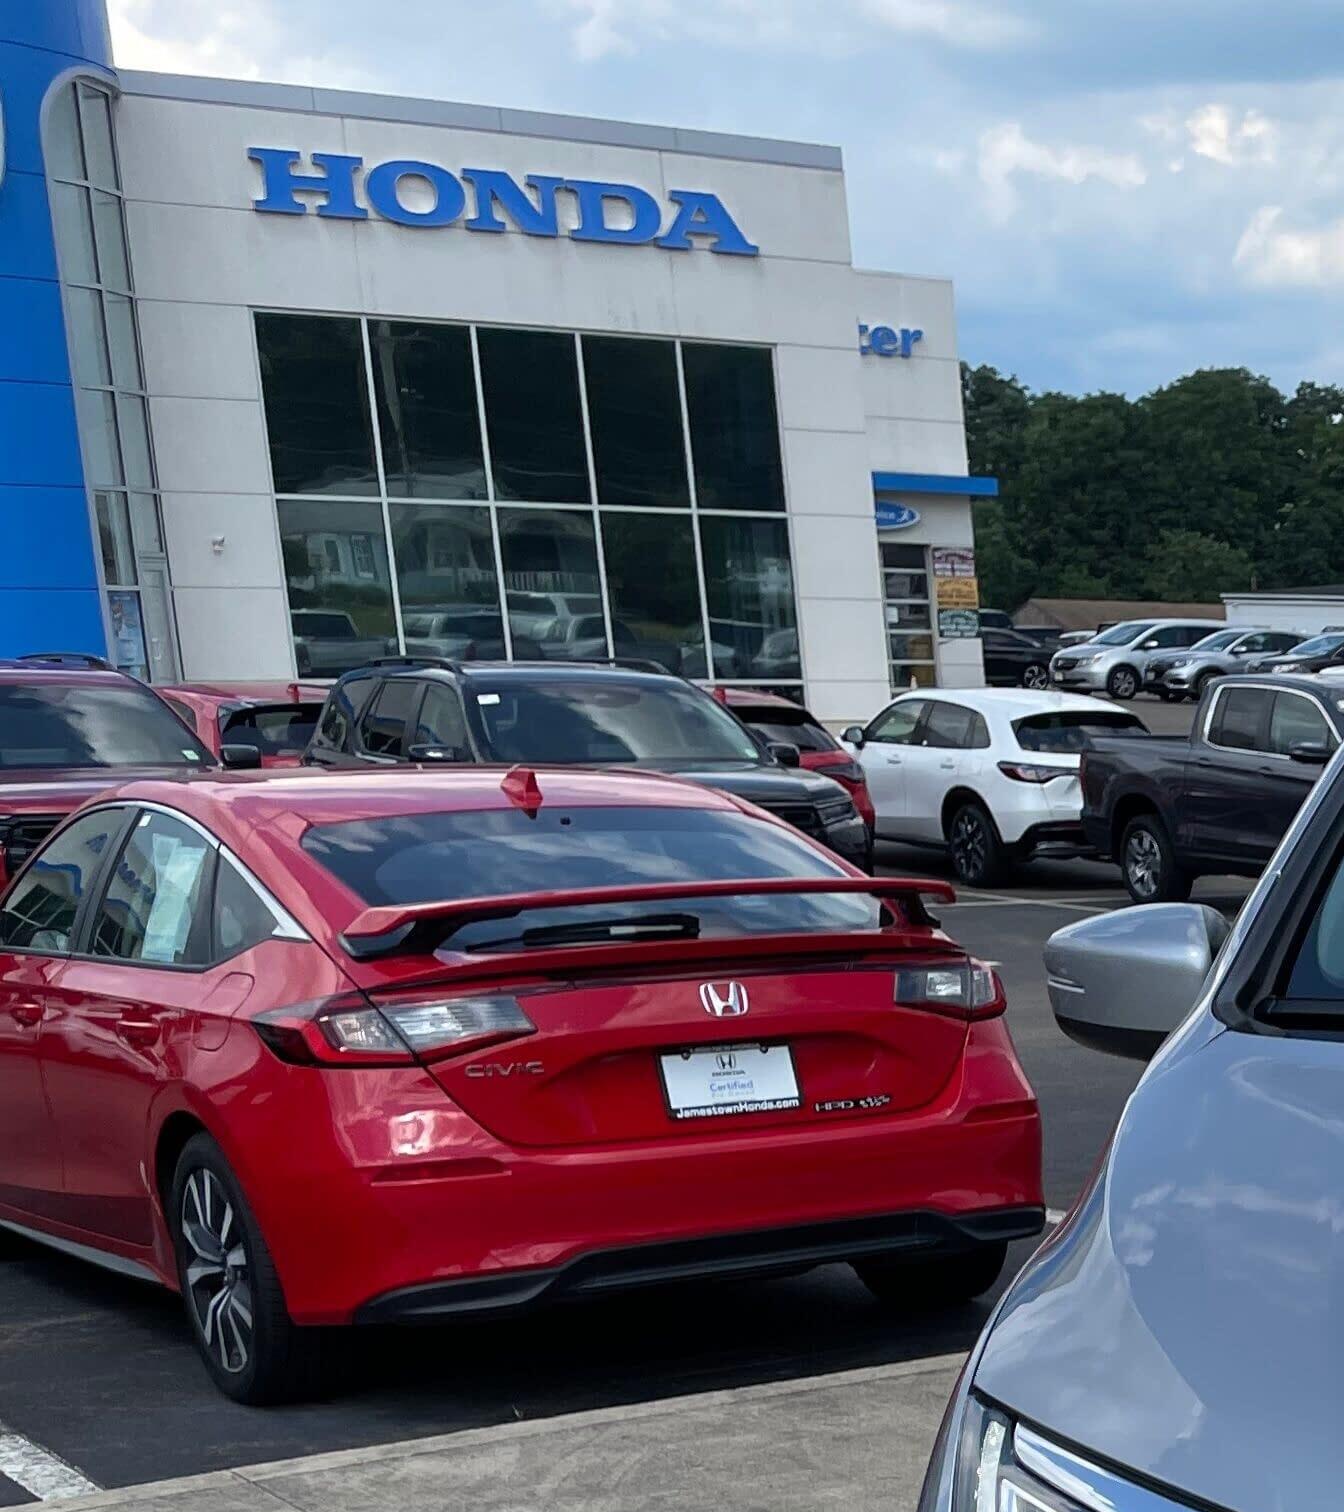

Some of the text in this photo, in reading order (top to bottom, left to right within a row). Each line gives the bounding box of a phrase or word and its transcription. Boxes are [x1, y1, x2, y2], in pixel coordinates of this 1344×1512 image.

[248, 147, 758, 257] HONDA
[465, 1061, 544, 1077] CIVIC
[709, 1080, 754, 1092] Certified
[676, 1098, 800, 1119] JamestownHonda.com
